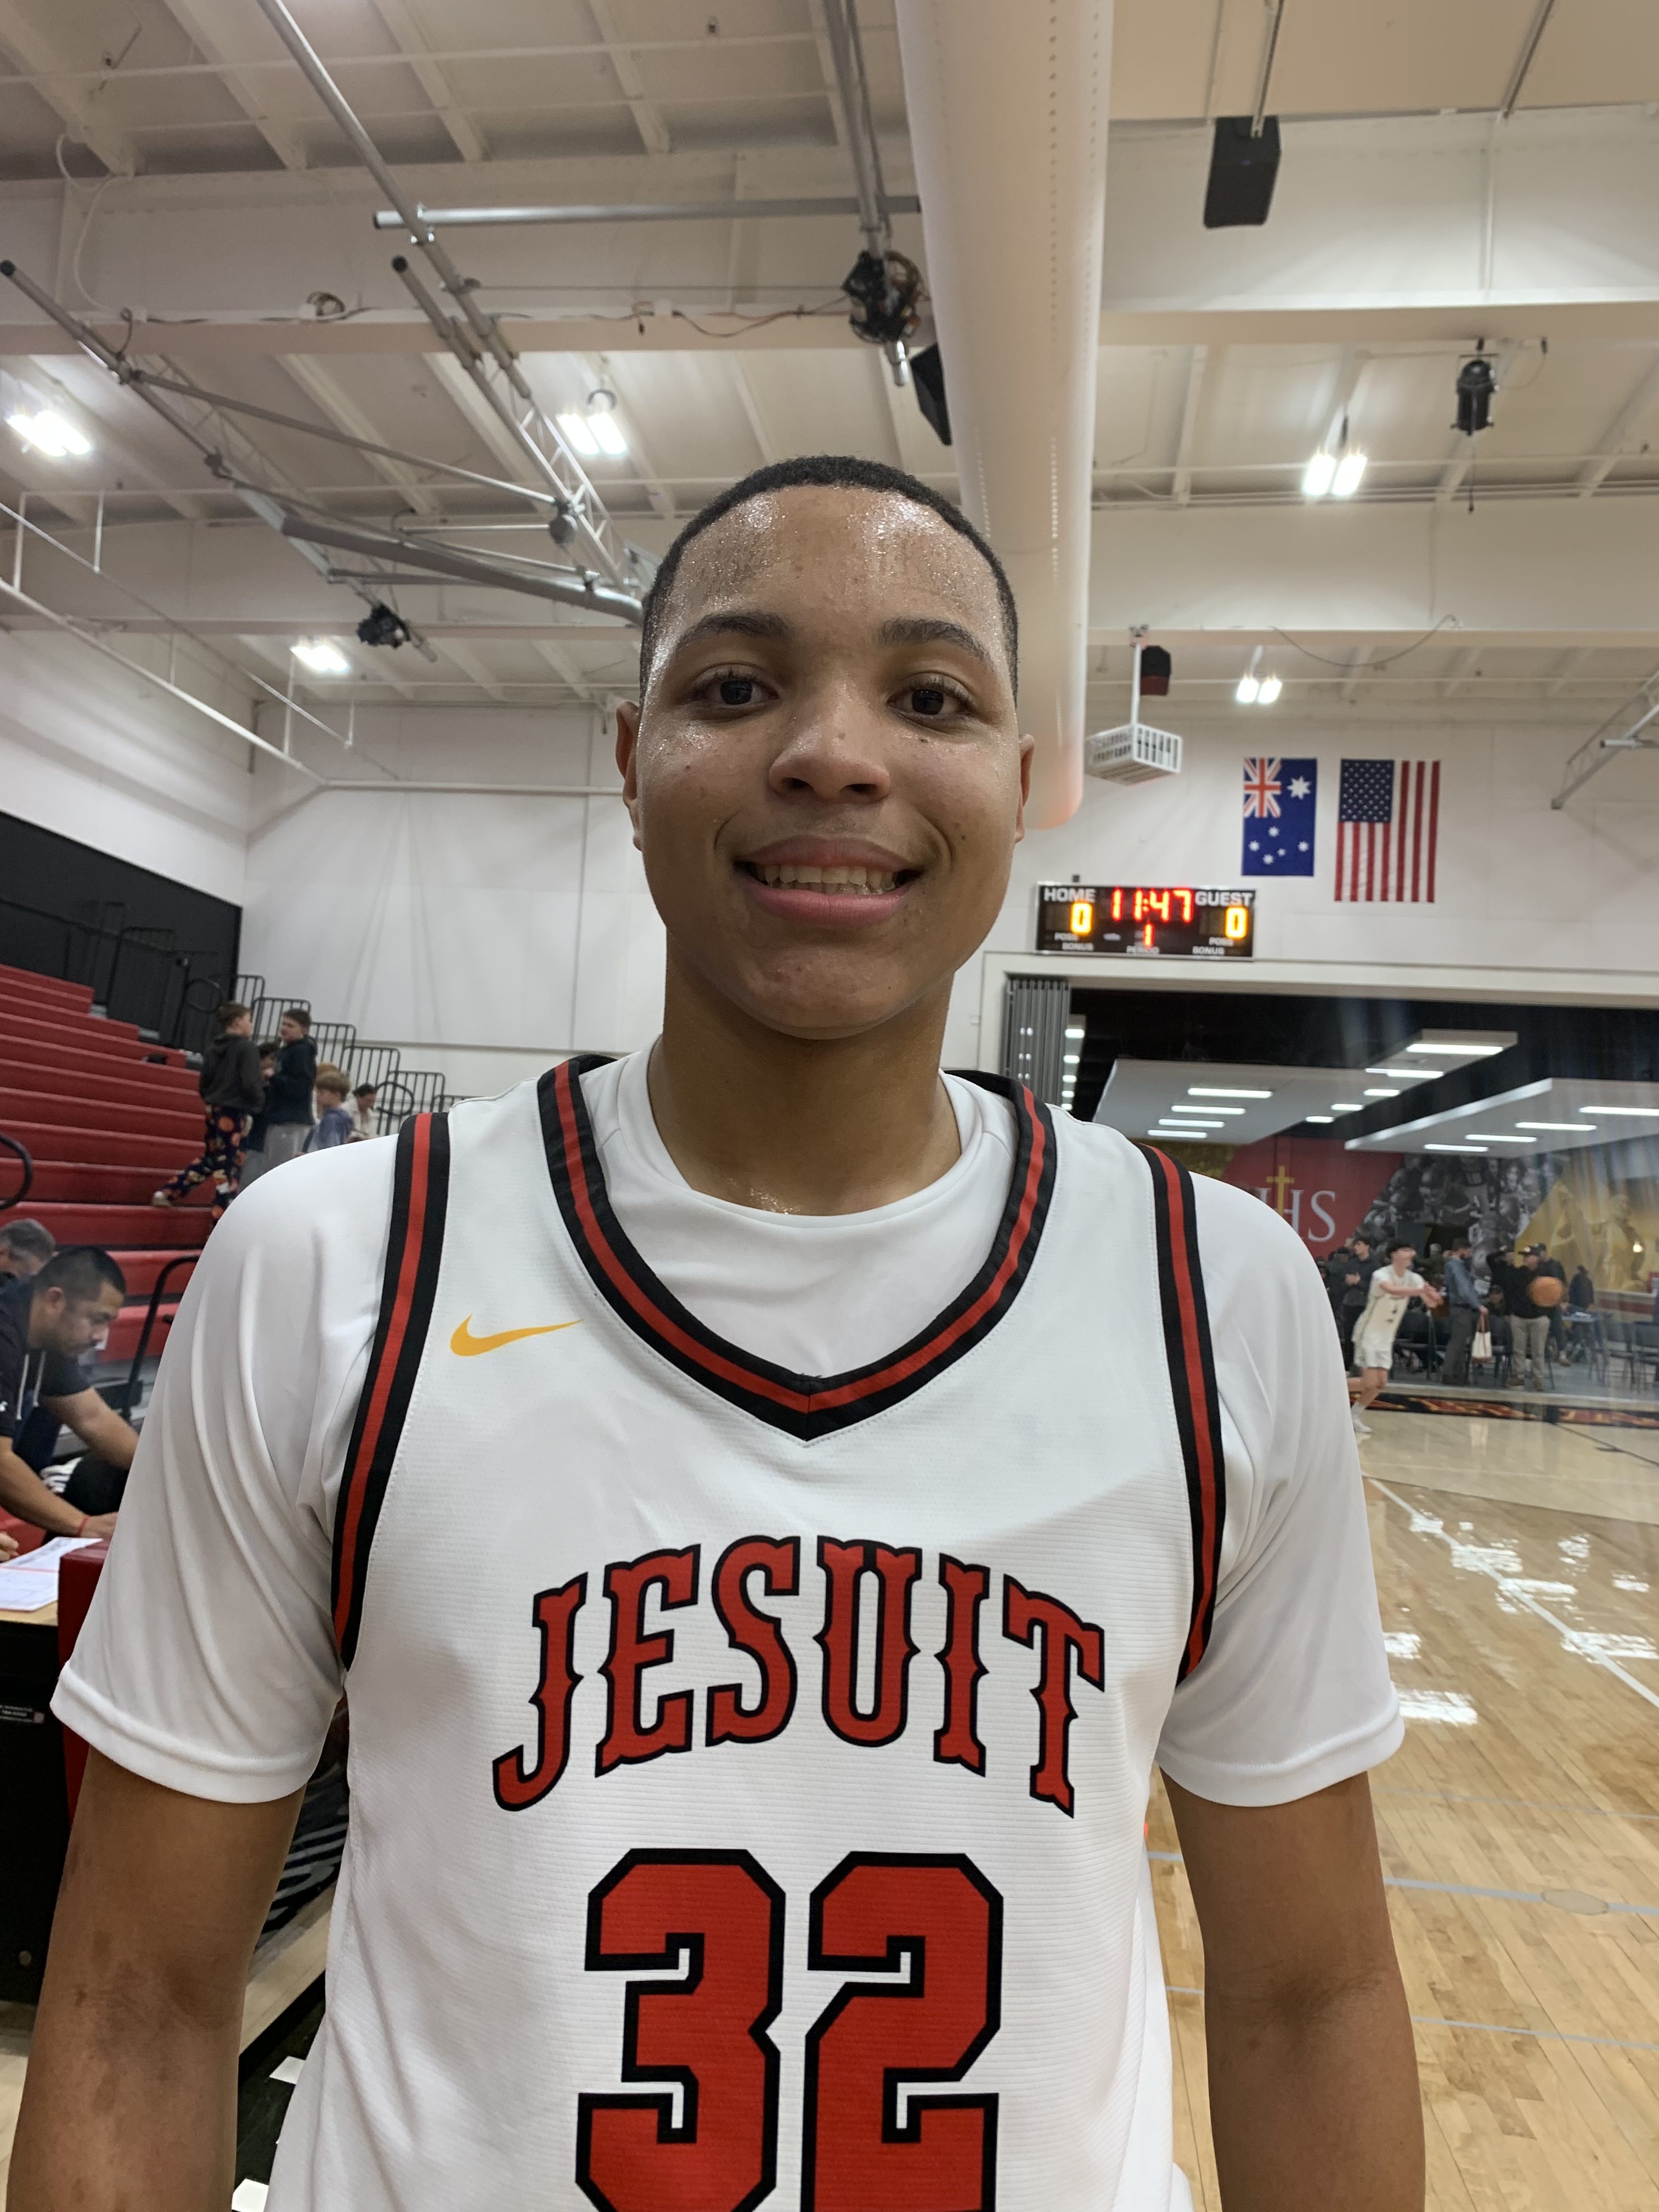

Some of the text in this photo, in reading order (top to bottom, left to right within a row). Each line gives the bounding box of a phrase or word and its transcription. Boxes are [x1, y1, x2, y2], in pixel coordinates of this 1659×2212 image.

[1044, 888, 1096, 903] HOME
[1111, 888, 1194, 922] 11:47
[1195, 891, 1253, 906] GUEST
[1071, 902, 1092, 934] 0
[1225, 906, 1247, 939] 0
[1062, 942, 1094, 951] BONUS
[1144, 923, 1154, 948] 1
[1126, 945, 1160, 954] PERIOD
[1193, 946, 1225, 956] BONUS
[493, 1534, 1105, 1819] JESUIT
[575, 1848, 1004, 2212] 32
